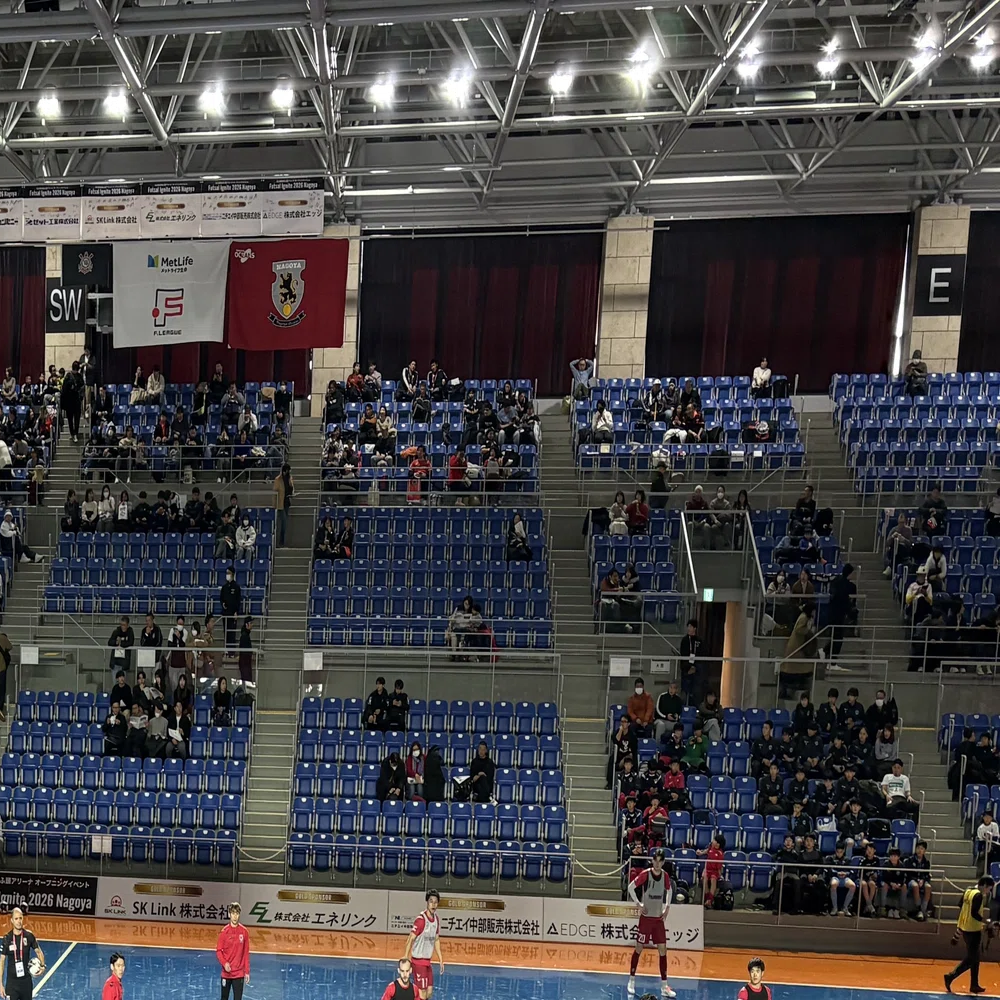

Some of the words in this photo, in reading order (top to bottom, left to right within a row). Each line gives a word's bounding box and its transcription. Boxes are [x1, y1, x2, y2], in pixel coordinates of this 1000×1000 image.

[161, 256, 194, 267] MetLife
[276, 262, 301, 270] NAGOYA
[929, 268, 952, 302] E
[50, 289, 82, 322] SW
[29, 892, 53, 907] 2026
[56, 894, 92, 912] Nagoya
[133, 901, 148, 915] SK
[151, 903, 176, 916] Link
[180, 903, 230, 920] 株式会社
[274, 912, 310, 922] 株式会社
[311, 912, 376, 928] エネリンク
[441, 917, 540, 936] ニチエイ中部販売株式会社
[560, 924, 596, 937] EDGE
